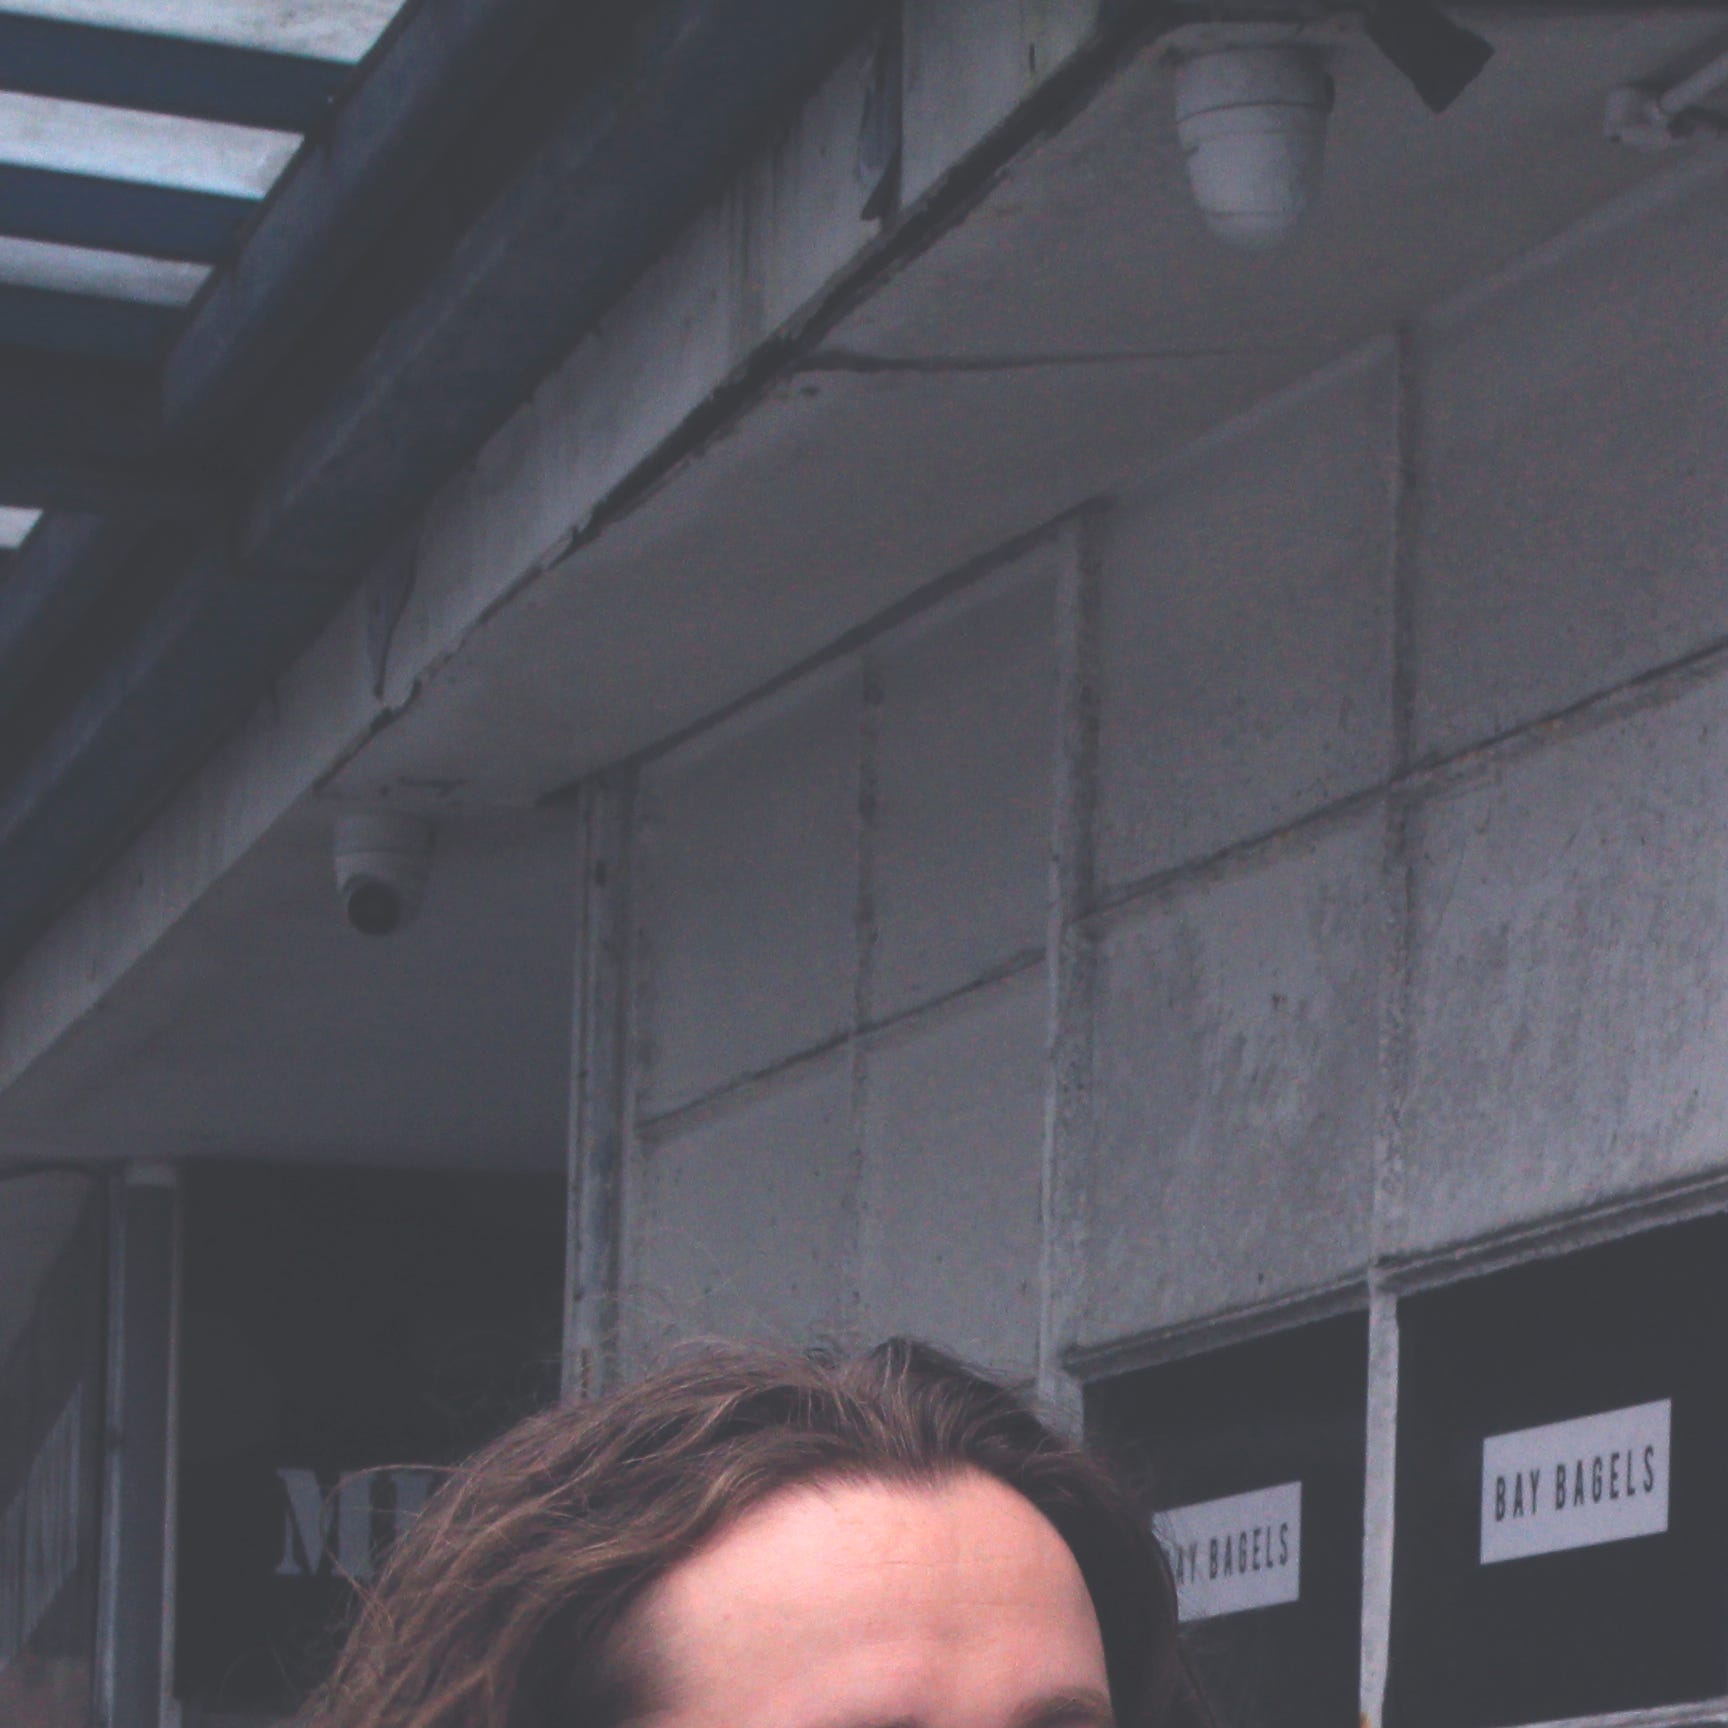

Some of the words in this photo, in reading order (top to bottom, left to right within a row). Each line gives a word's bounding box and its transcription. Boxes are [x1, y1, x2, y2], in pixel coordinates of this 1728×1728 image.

[1494, 1468, 1541, 1523] BAY
[1555, 1444, 1655, 1512] BAGELS
[1170, 1540, 1198, 1586] AY
[1208, 1522, 1290, 1581] BAGELS
